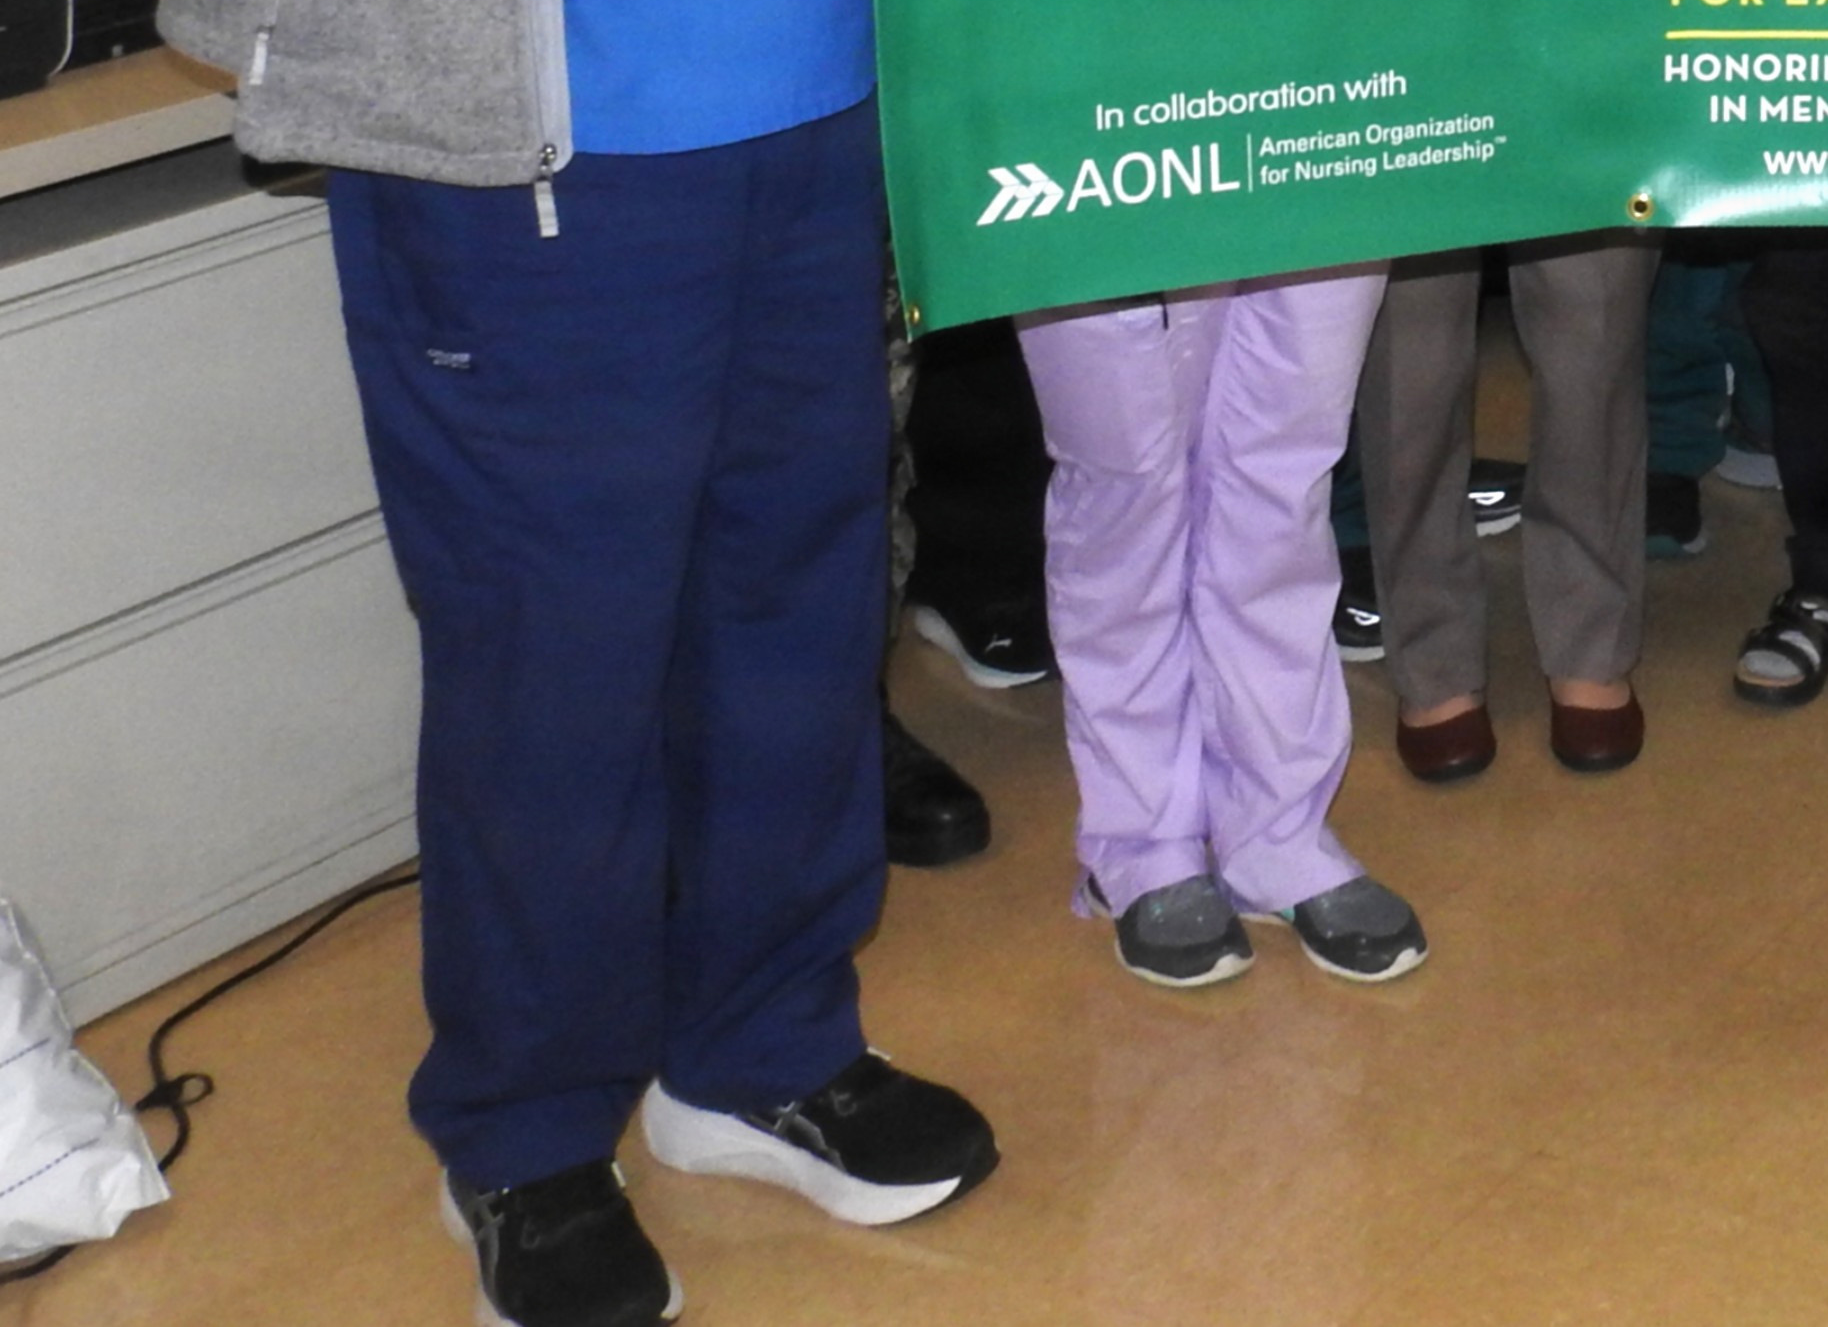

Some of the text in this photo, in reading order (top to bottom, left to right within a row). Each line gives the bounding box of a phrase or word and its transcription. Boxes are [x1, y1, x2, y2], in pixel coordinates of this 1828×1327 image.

[1096, 70, 1407, 130] In collaboration with
[1710, 94, 1747, 123] IN
[1259, 114, 1495, 157] American Organization
[1066, 142, 1241, 212] AONL
[1260, 165, 1288, 185] for
[1294, 155, 1377, 182] Nursing
